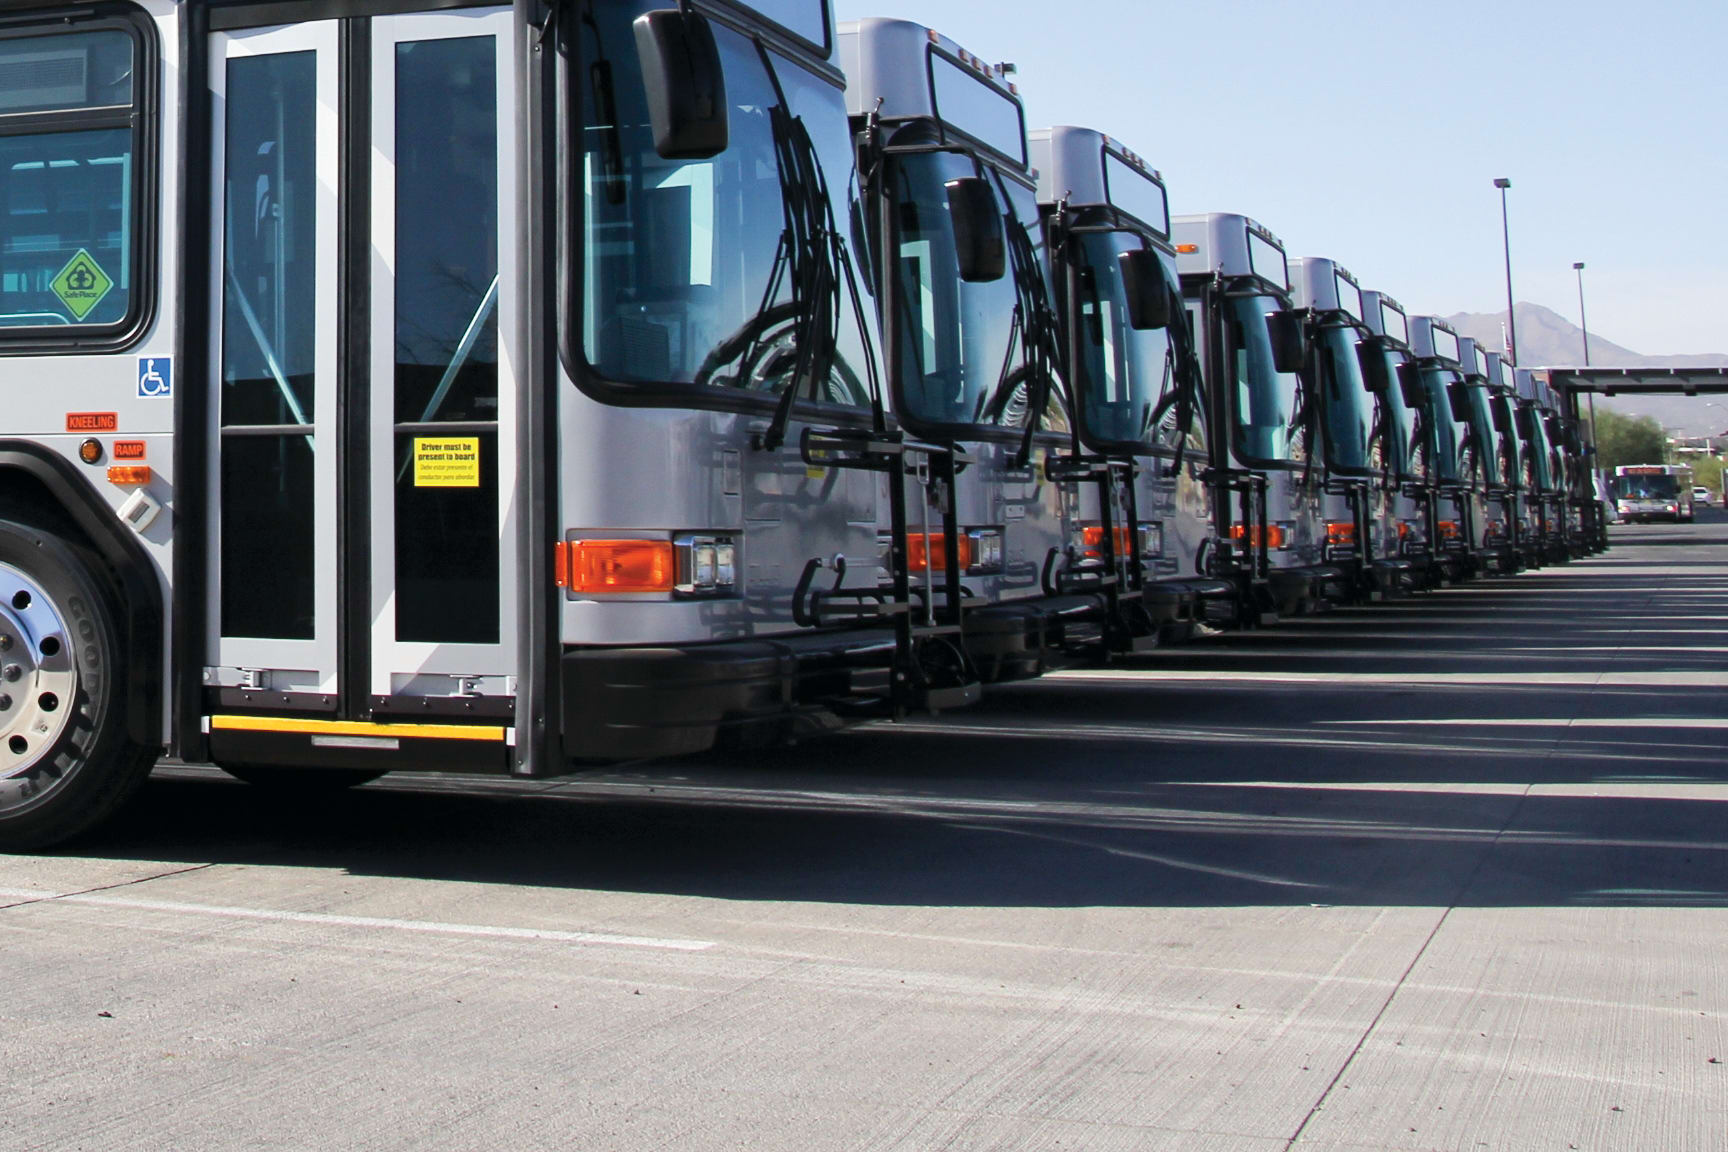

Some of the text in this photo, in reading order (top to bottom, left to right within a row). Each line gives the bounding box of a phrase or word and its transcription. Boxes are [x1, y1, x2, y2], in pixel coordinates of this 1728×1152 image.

[69, 415, 114, 428] KNEELING
[116, 445, 143, 457] RAMP
[421, 443, 472, 451] Driver must be
[418, 453, 445, 461] present
